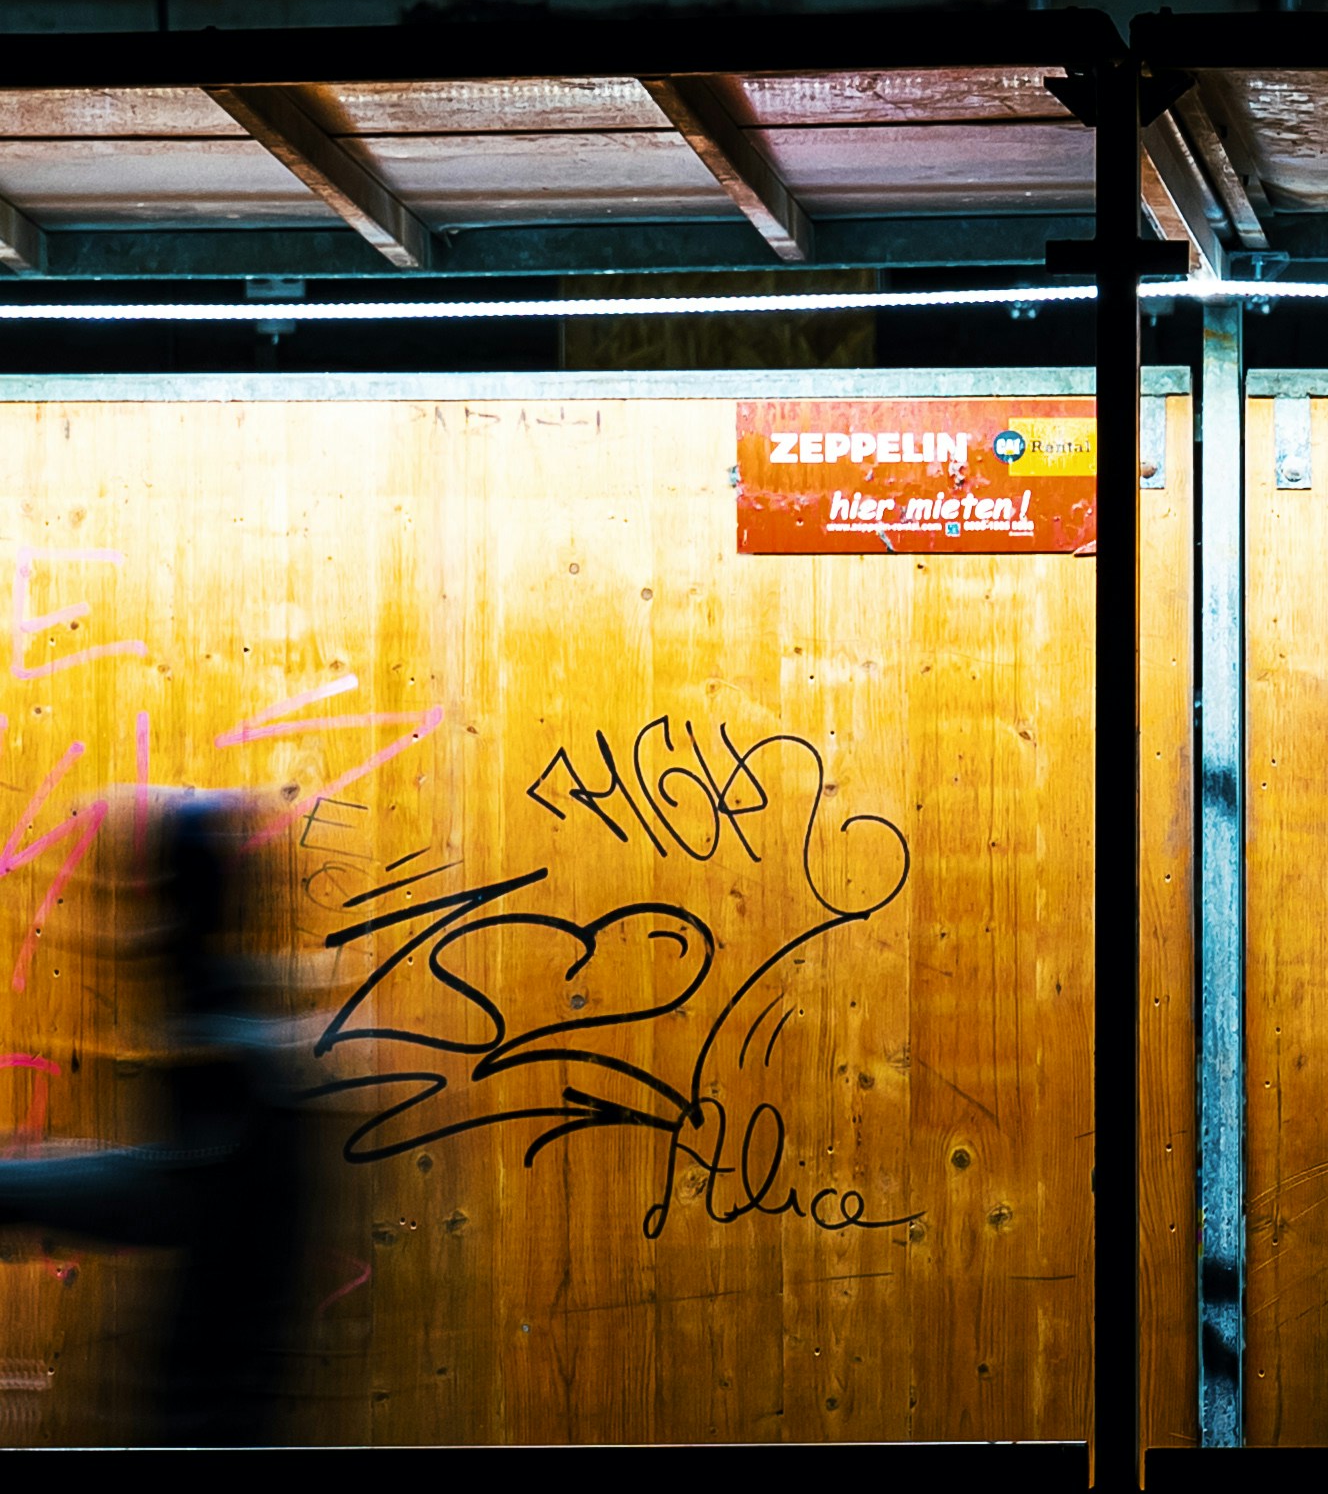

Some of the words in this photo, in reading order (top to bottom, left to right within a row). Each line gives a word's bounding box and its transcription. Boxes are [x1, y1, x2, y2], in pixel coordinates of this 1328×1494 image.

[769, 432, 967, 463] ZEPPELIN
[1031, 439, 1091, 454] Rental
[829, 490, 896, 521] hier
[905, 489, 1032, 521] mieten!
